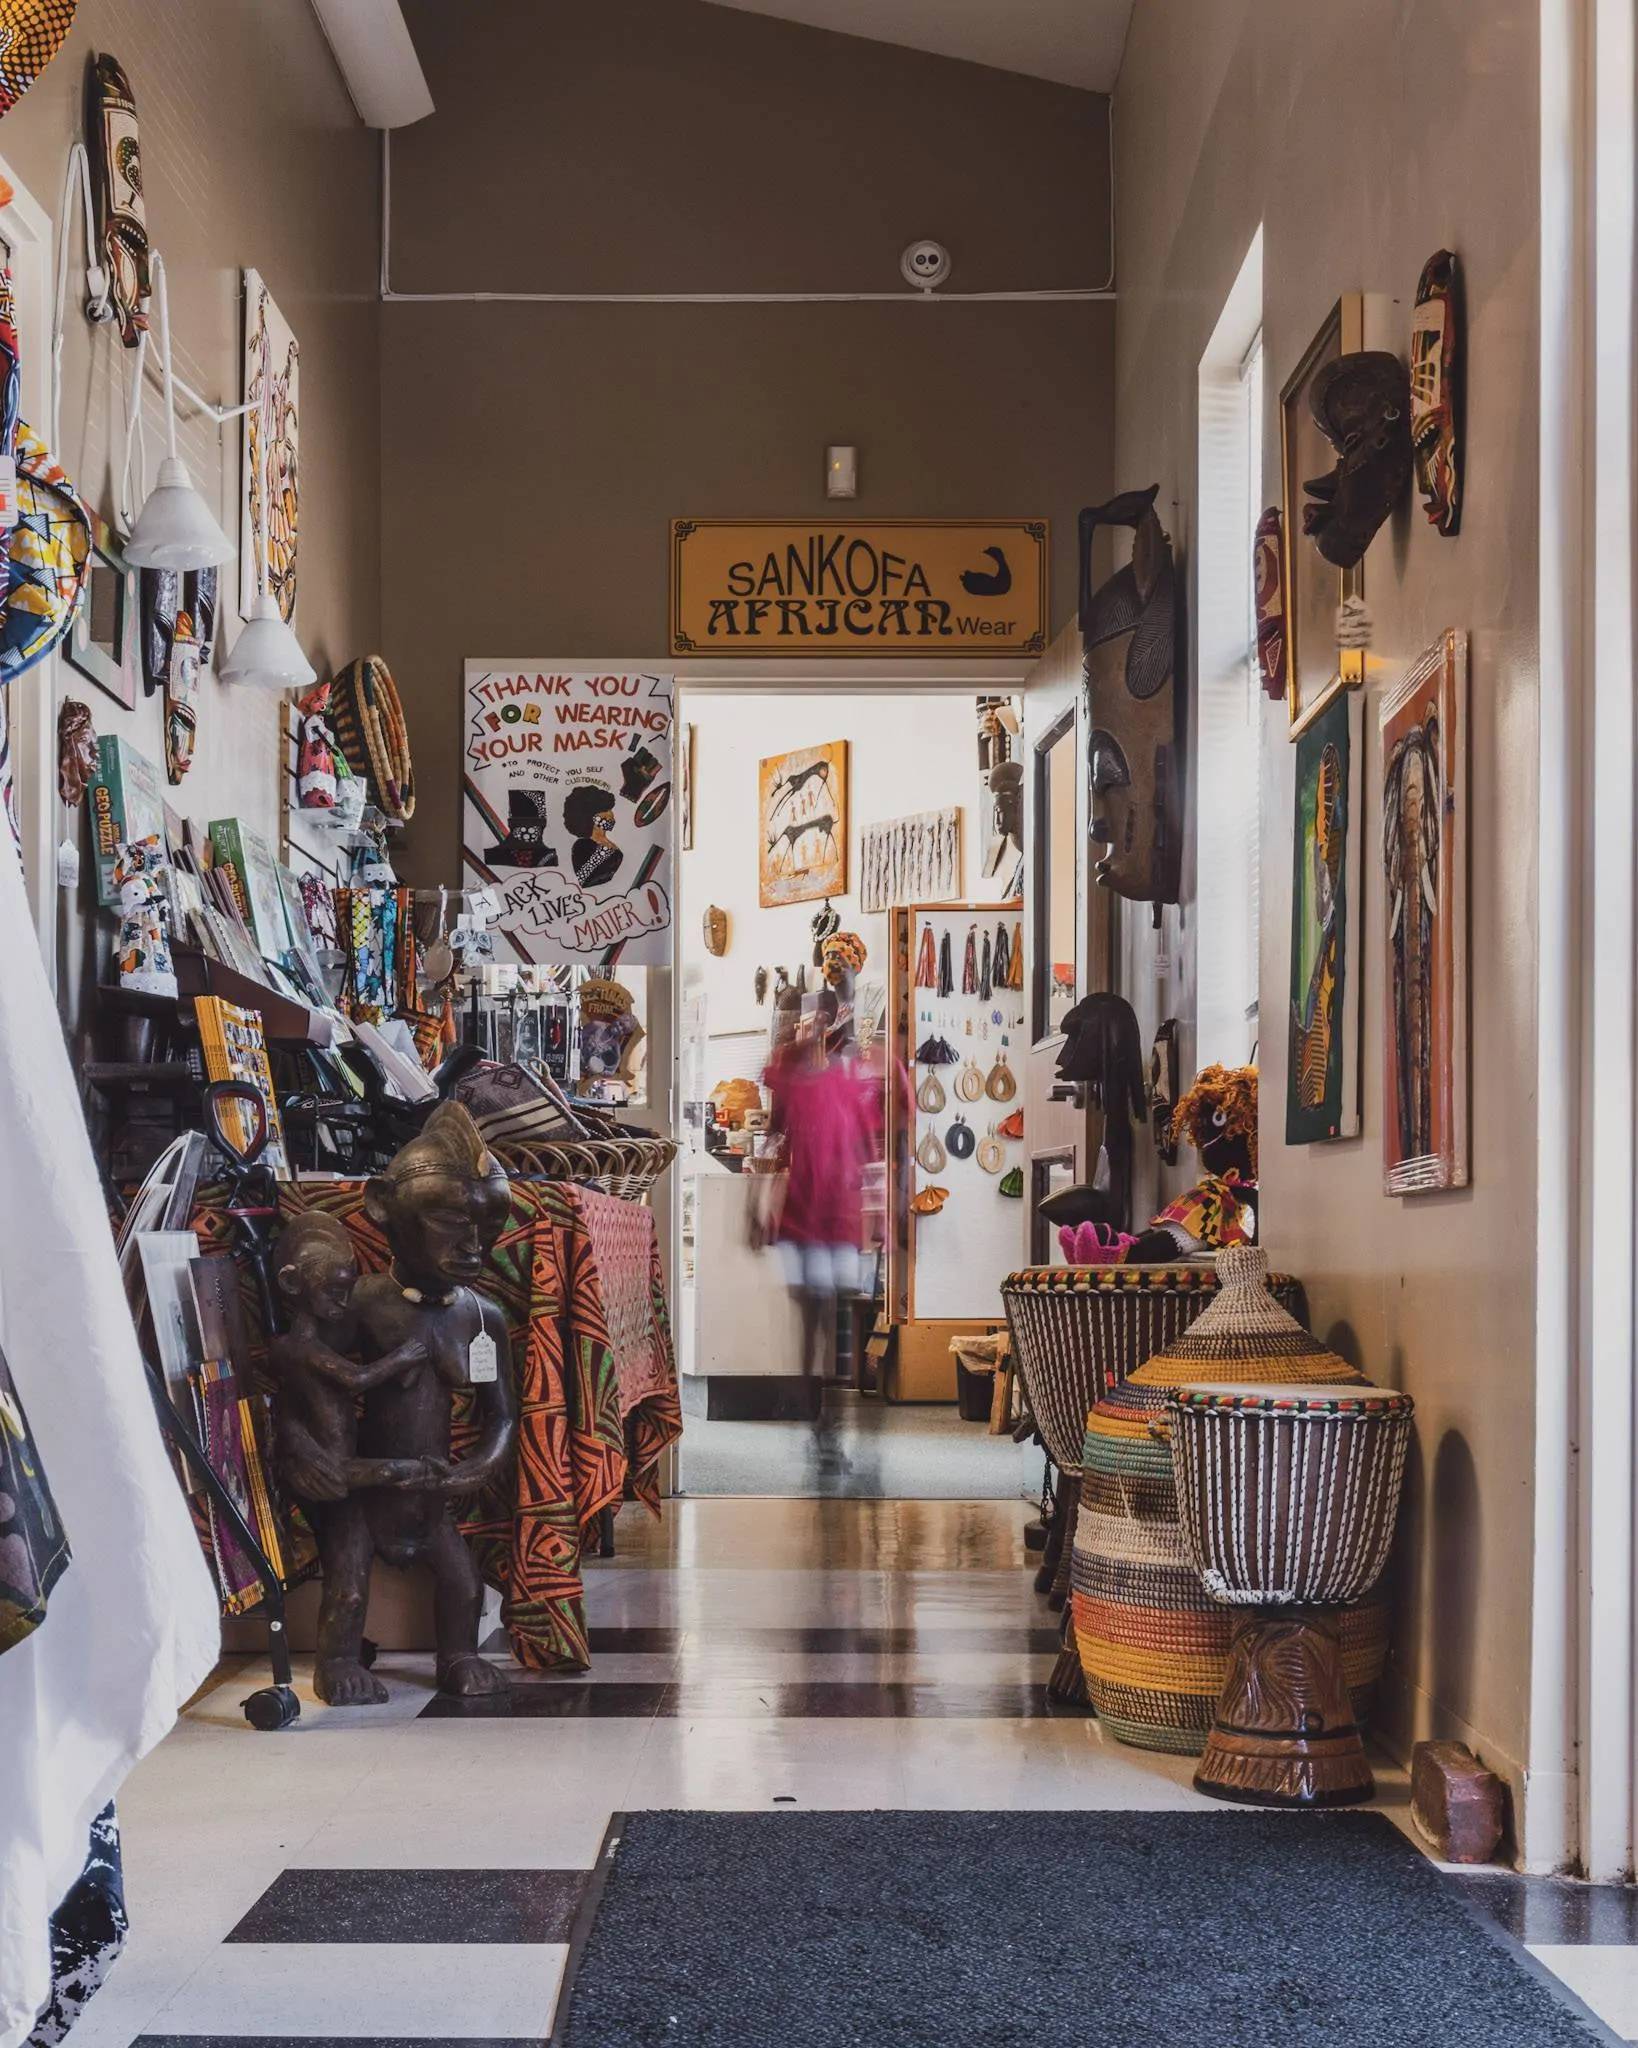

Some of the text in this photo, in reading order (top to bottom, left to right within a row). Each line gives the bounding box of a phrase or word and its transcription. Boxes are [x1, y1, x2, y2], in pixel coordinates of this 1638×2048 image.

[727, 534, 932, 597] SANKOFA
[706, 598, 1017, 636] AFRICAN Wear
[478, 673, 640, 703] THANK YOU
[484, 702, 669, 733] FOR WEARING
[472, 732, 543, 762] YOUR
[509, 770, 525, 779] AND
[533, 773, 559, 784] OTHER
[527, 759, 560, 775] PROTECT
[565, 767, 582, 776] YOU
[95, 786, 111, 812] GEO
[98, 812, 115, 855] PUZZLE
[486, 876, 551, 925] ACK
[528, 893, 586, 927] LIVES
